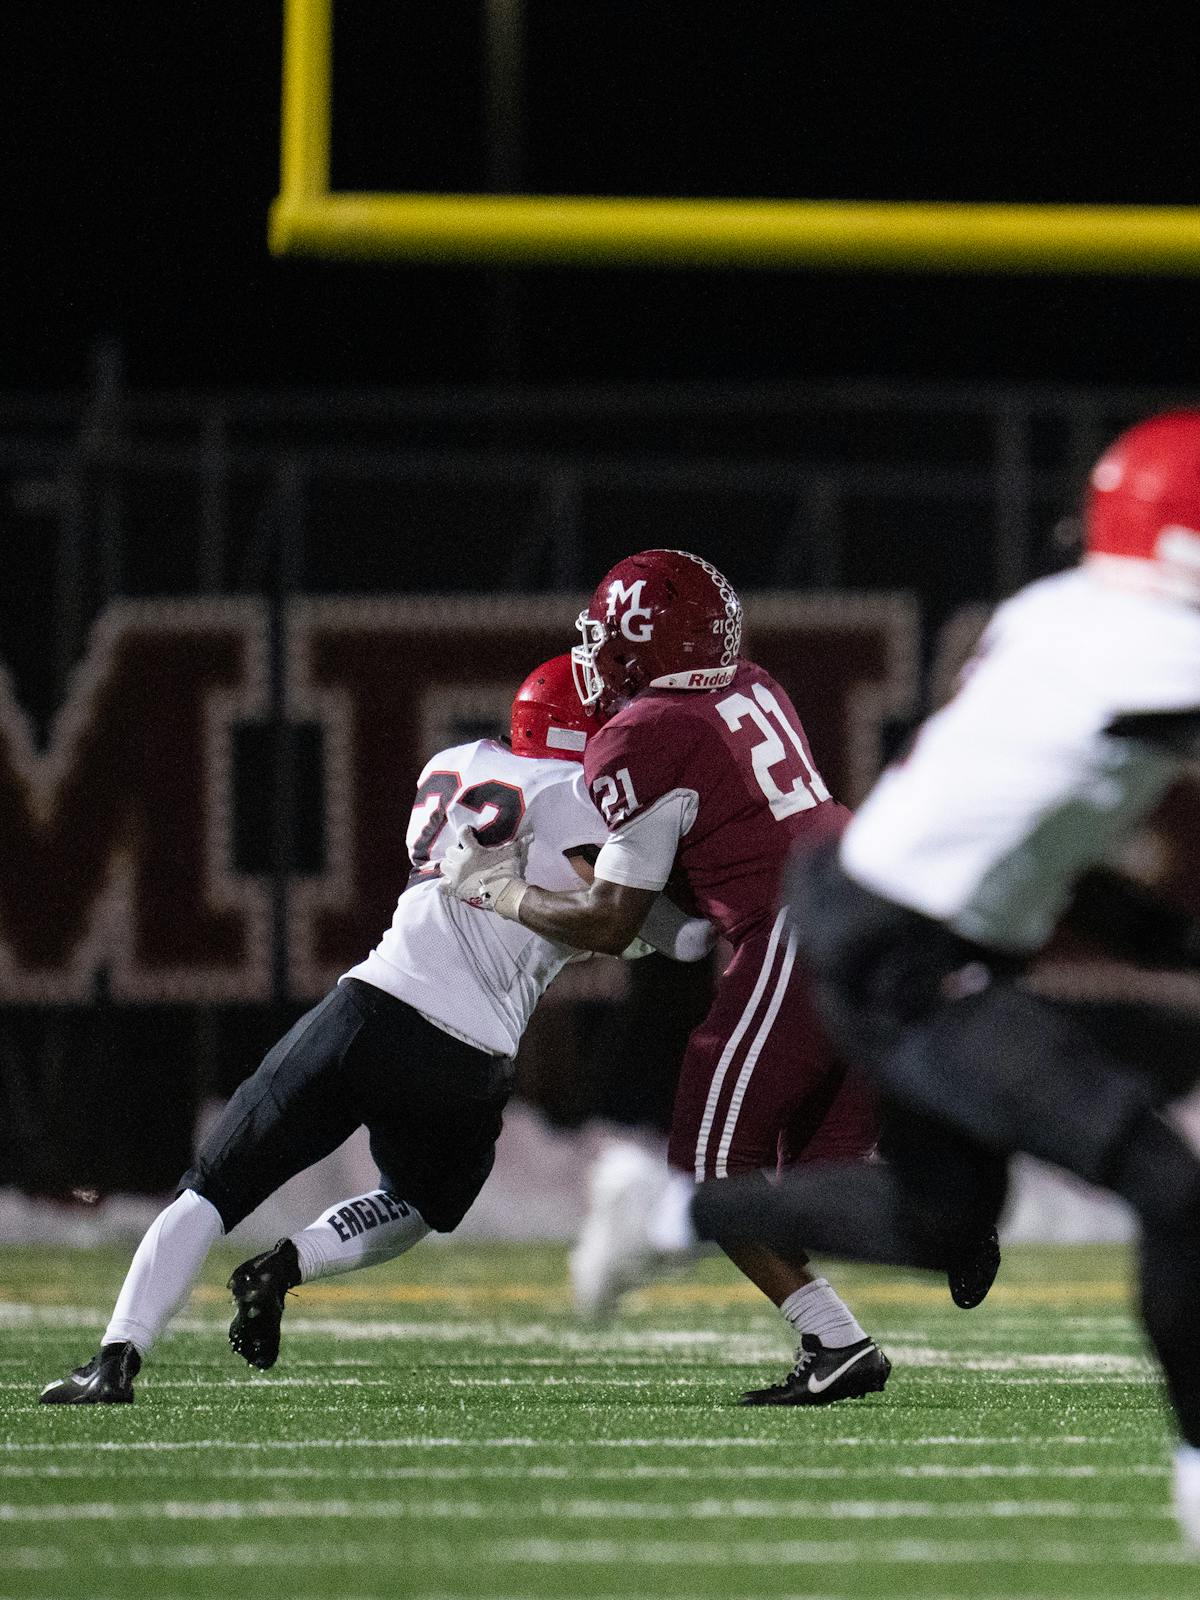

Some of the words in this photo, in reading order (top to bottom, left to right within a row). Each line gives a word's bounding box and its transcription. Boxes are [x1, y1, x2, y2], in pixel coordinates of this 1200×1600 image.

[712, 619, 724, 634] 21
[714, 682, 833, 821] 21
[592, 767, 639, 823] 21
